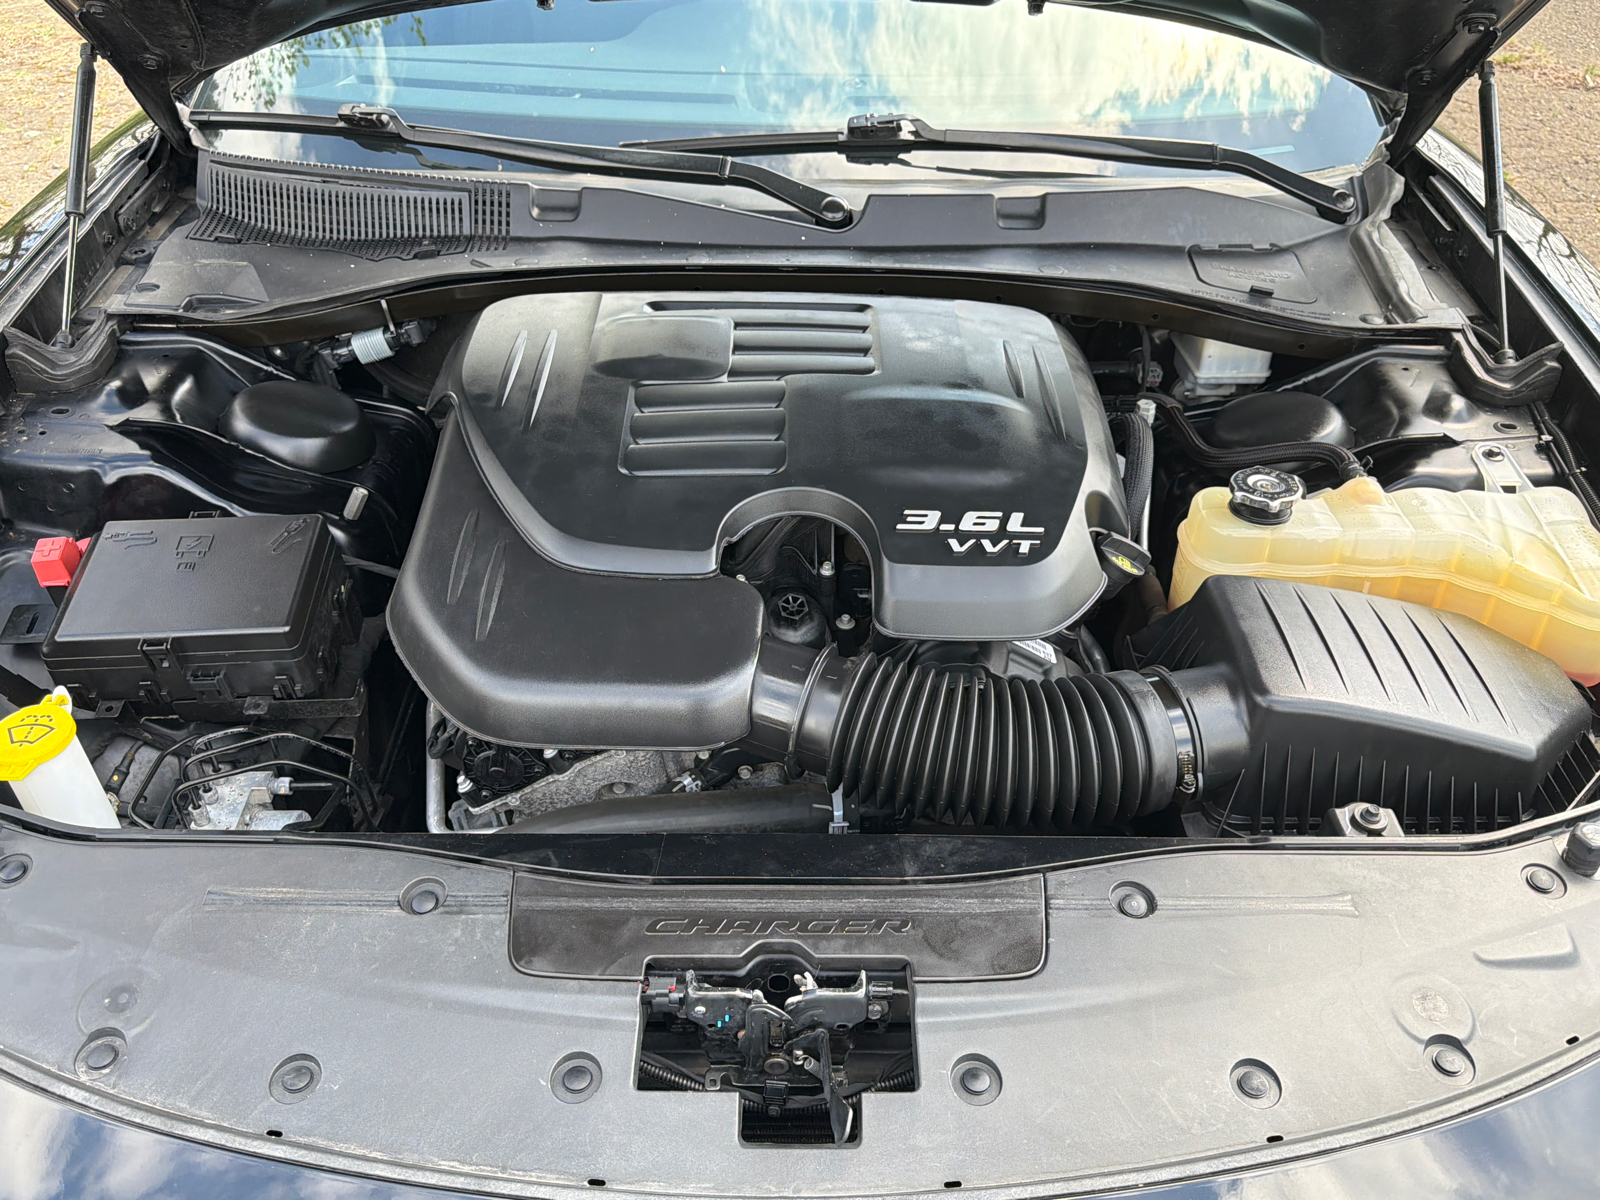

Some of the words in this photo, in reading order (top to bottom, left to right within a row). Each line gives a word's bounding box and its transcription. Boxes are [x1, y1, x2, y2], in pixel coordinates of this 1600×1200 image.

[1255, 269, 1291, 279] FLUID
[896, 509, 1045, 534] 3.6L
[946, 538, 1041, 556] VVT
[645, 918, 911, 935] CHARGER
